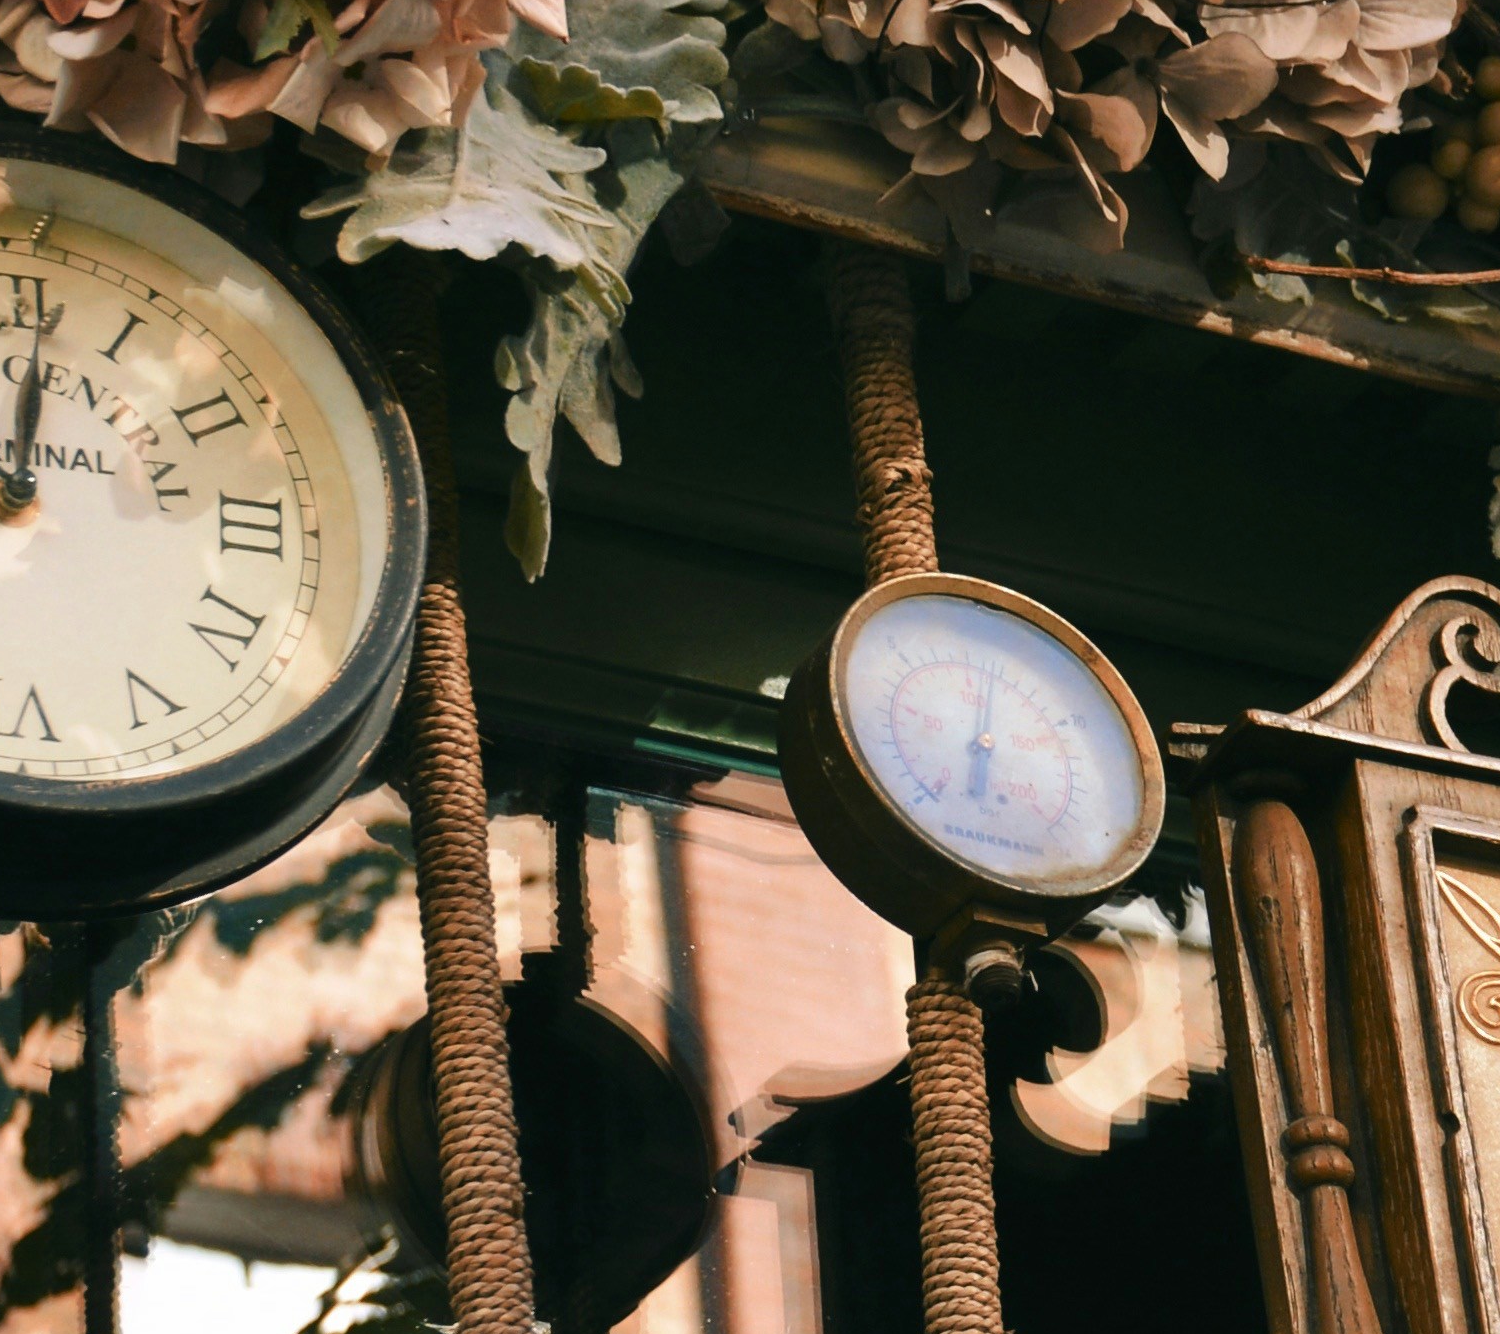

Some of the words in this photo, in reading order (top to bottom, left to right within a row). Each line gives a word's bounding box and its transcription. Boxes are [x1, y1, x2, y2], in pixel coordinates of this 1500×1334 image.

[94, 307, 148, 365] I
[2, 353, 192, 513] CENTRAL
[174, 387, 247, 447] II
[218, 491, 284, 562] III
[186, 585, 266, 673] IV
[126, 667, 188, 730] V
